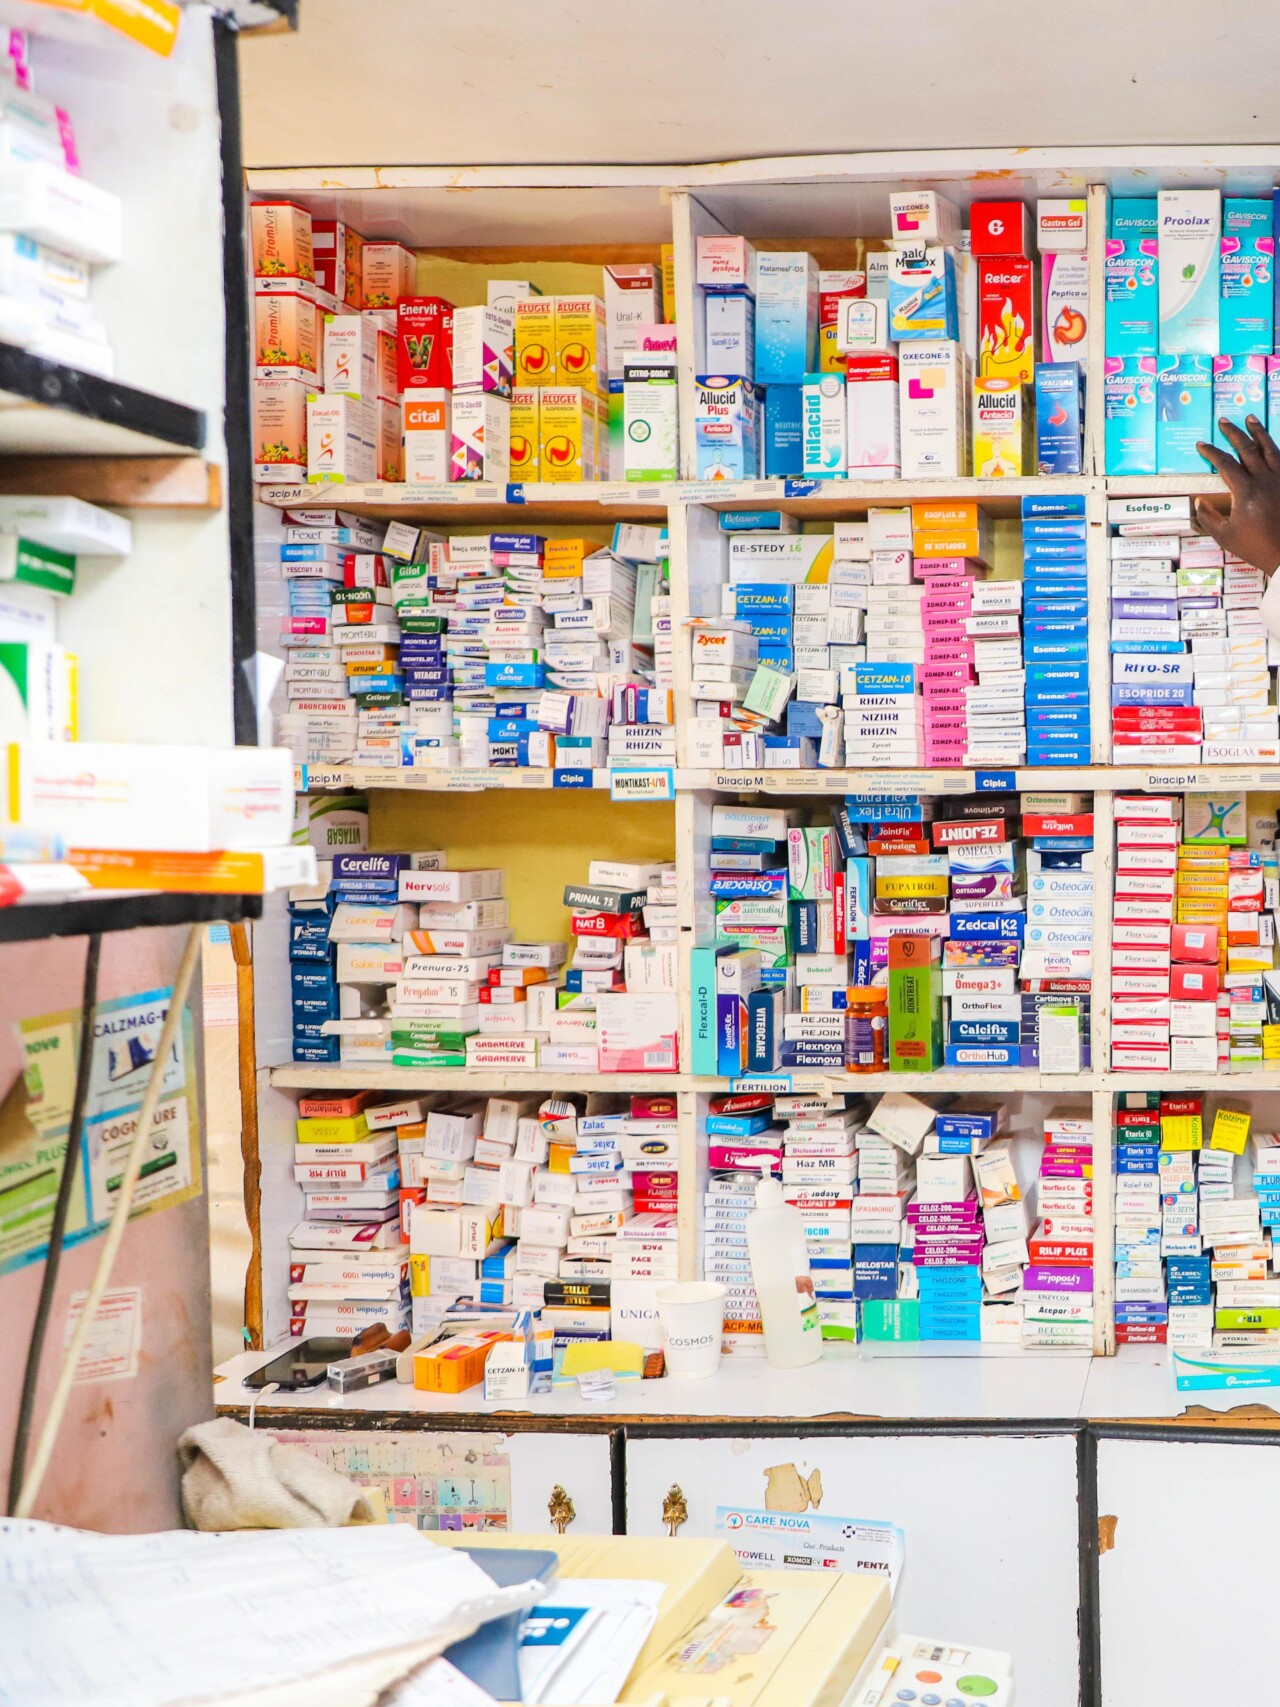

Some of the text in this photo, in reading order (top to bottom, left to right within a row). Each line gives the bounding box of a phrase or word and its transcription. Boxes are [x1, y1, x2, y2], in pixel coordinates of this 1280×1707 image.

[1042, 219, 1081, 227] Gastro Gel
[1164, 216, 1209, 226] Proolax
[1107, 258, 1154, 268] GAVISCON
[1222, 255, 1269, 264] GAVISCON
[985, 273, 1022, 285] Relcer
[1052, 290, 1079, 299] Peptica
[400, 303, 438, 316] Enervit
[517, 303, 551, 313] ALUGEL
[616, 312, 642, 322] Ural-K
[268, 297, 279, 347] PromiVit
[902, 352, 950, 360] OXECONE-S
[629, 370, 670, 379] CITRO-SODA
[700, 392, 736, 405] Allucid
[707, 405, 729, 416] Plus
[981, 411, 1013, 419] Antacid
[409, 410, 440, 424] cital
[806, 394, 821, 464] Nilacid
[792, 480, 815, 488] Cipla
[1032, 503, 1076, 512] Esomac-20
[1126, 503, 1171, 512] Esofag-D
[292, 529, 323, 540] Fexet
[733, 545, 784, 553] BE-STEDY
[399, 566, 420, 575] Gifol
[697, 634, 725, 645] Zycet
[505, 652, 525, 661] Rupa
[1125, 663, 1179, 673] RITO-SR
[857, 675, 911, 684] CETZAN-10
[411, 688, 438, 697] VITAGET
[1119, 689, 1170, 698] ESOPRIDE
[860, 697, 896, 705] RHIZIN
[299, 702, 346, 710] BRONCHOWIN
[717, 776, 763, 786] Diracip M
[1026, 797, 1067, 805] Osteomove
[856, 806, 911, 819] Ultra Flex
[880, 827, 910, 836] JointFix
[941, 825, 998, 839] ZEJOINT
[327, 828, 361, 845] VITAGAB
[881, 843, 915, 851] Myoatom
[957, 846, 1001, 856] OMEGA-3
[341, 858, 389, 871] Cerelife
[405, 882, 450, 891] Nervsols
[714, 881, 773, 893] Osteocare
[569, 893, 601, 904] PRINAL
[890, 899, 927, 908] Cartiflex
[576, 918, 605, 928] NAT B
[957, 918, 1017, 930] Zedcal K2
[1001, 929, 1017, 937] Plus
[412, 963, 469, 973] Prenura-75
[955, 980, 1002, 991] Omega 3+
[1035, 995, 1070, 1003] Cartimove
[961, 1002, 1002, 1011] OrthoFlex
[698, 987, 708, 1039] Flexcal-D
[757, 1008, 765, 1058] VITEOCARE
[959, 1024, 1008, 1036] Calcifix
[796, 1055, 841, 1064] Flexnova
[960, 1050, 1005, 1061] OrthoHub
[736, 1083, 786, 1091] FERTILION
[1218, 1113, 1247, 1125] Kolzine
[583, 1120, 605, 1129] Zalac
[1125, 1130, 1143, 1139] Etorix
[796, 1159, 834, 1168] Haz MR
[1043, 1184, 1065, 1192] Norflex
[920, 1204, 951, 1213] CELOZ-200
[1038, 1246, 1088, 1257] RILIF PLUS
[1219, 1250, 1238, 1258] Soral
[1039, 1306, 1080, 1315] Acepar-SP
[669, 1337, 714, 1346] COSMOS
[746, 1515, 776, 1526] CARE
[779, 1518, 810, 1529] NOVA
[819, 1544, 845, 1552] Products
